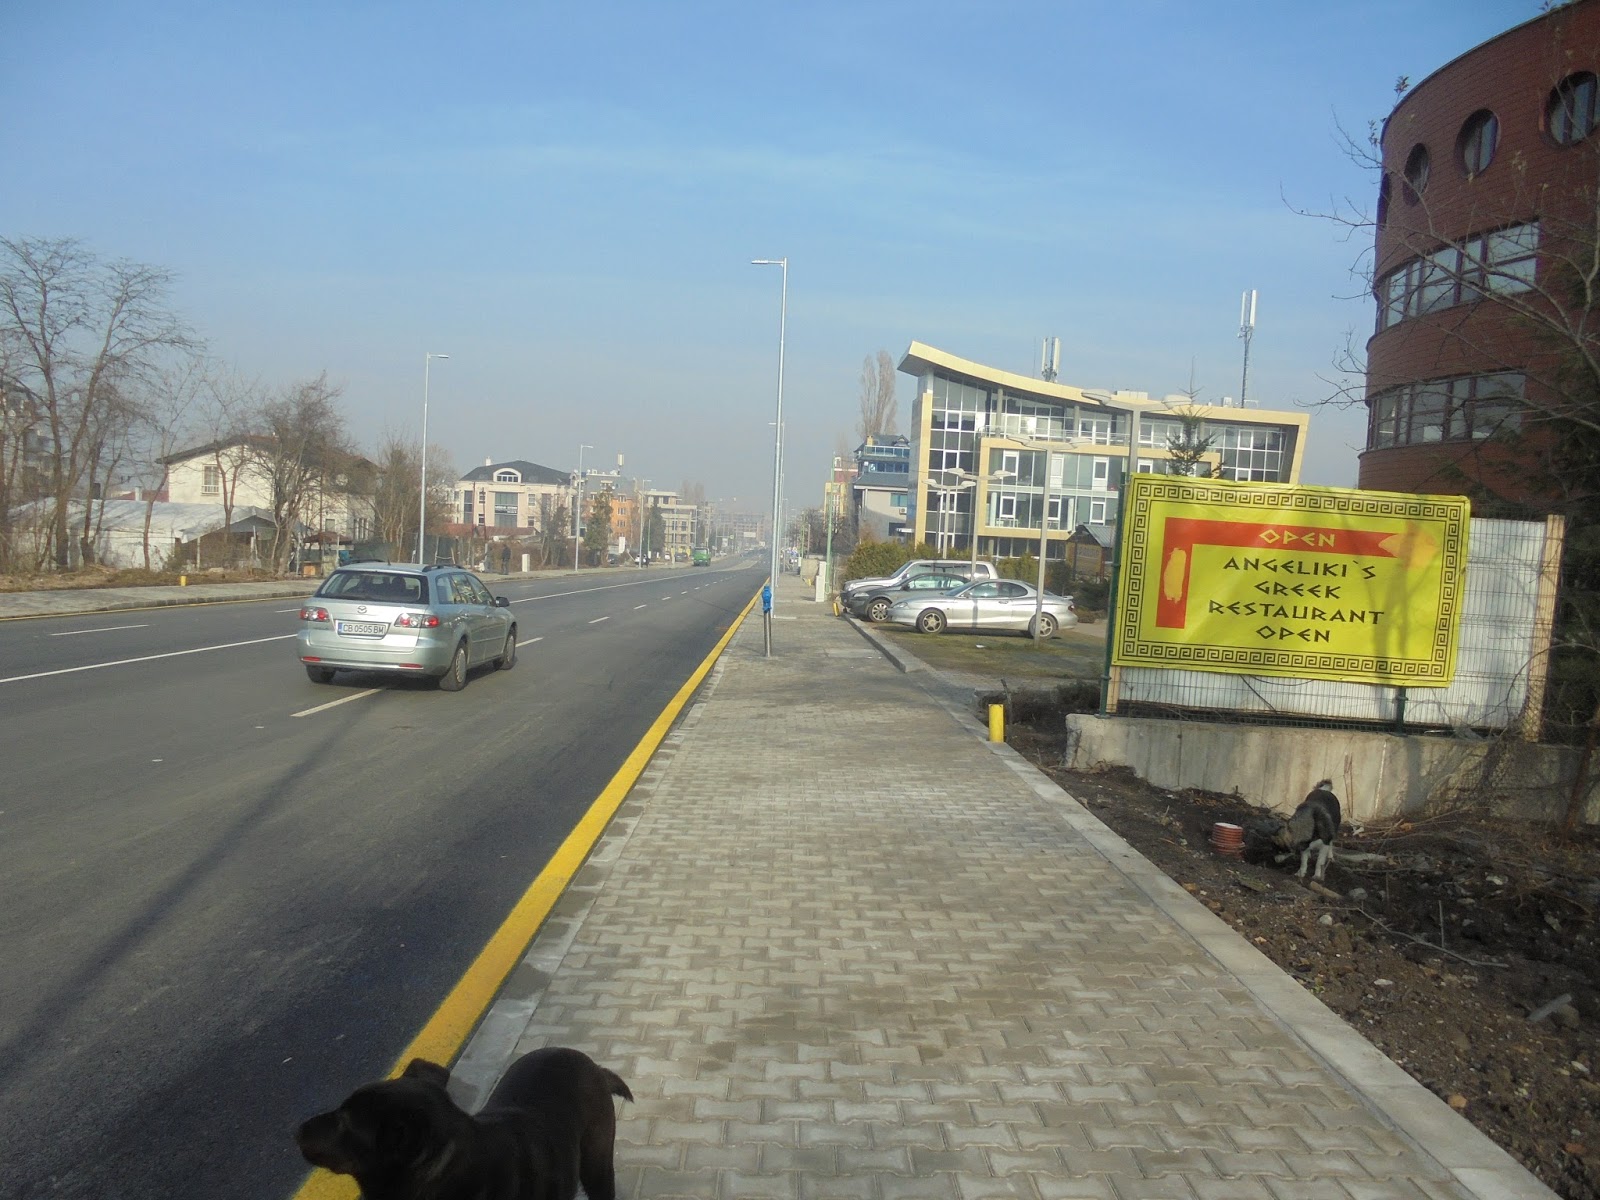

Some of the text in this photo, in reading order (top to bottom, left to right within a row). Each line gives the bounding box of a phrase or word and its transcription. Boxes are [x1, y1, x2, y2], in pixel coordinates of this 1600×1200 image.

[1259, 529, 1335, 547] OPEN
[1254, 581, 1341, 599] GREEK
[1209, 600, 1384, 625] RESTAURANT
[343, 624, 353, 632] CB
[354, 625, 373, 634] 0505
[1256, 625, 1330, 643] OPEN
